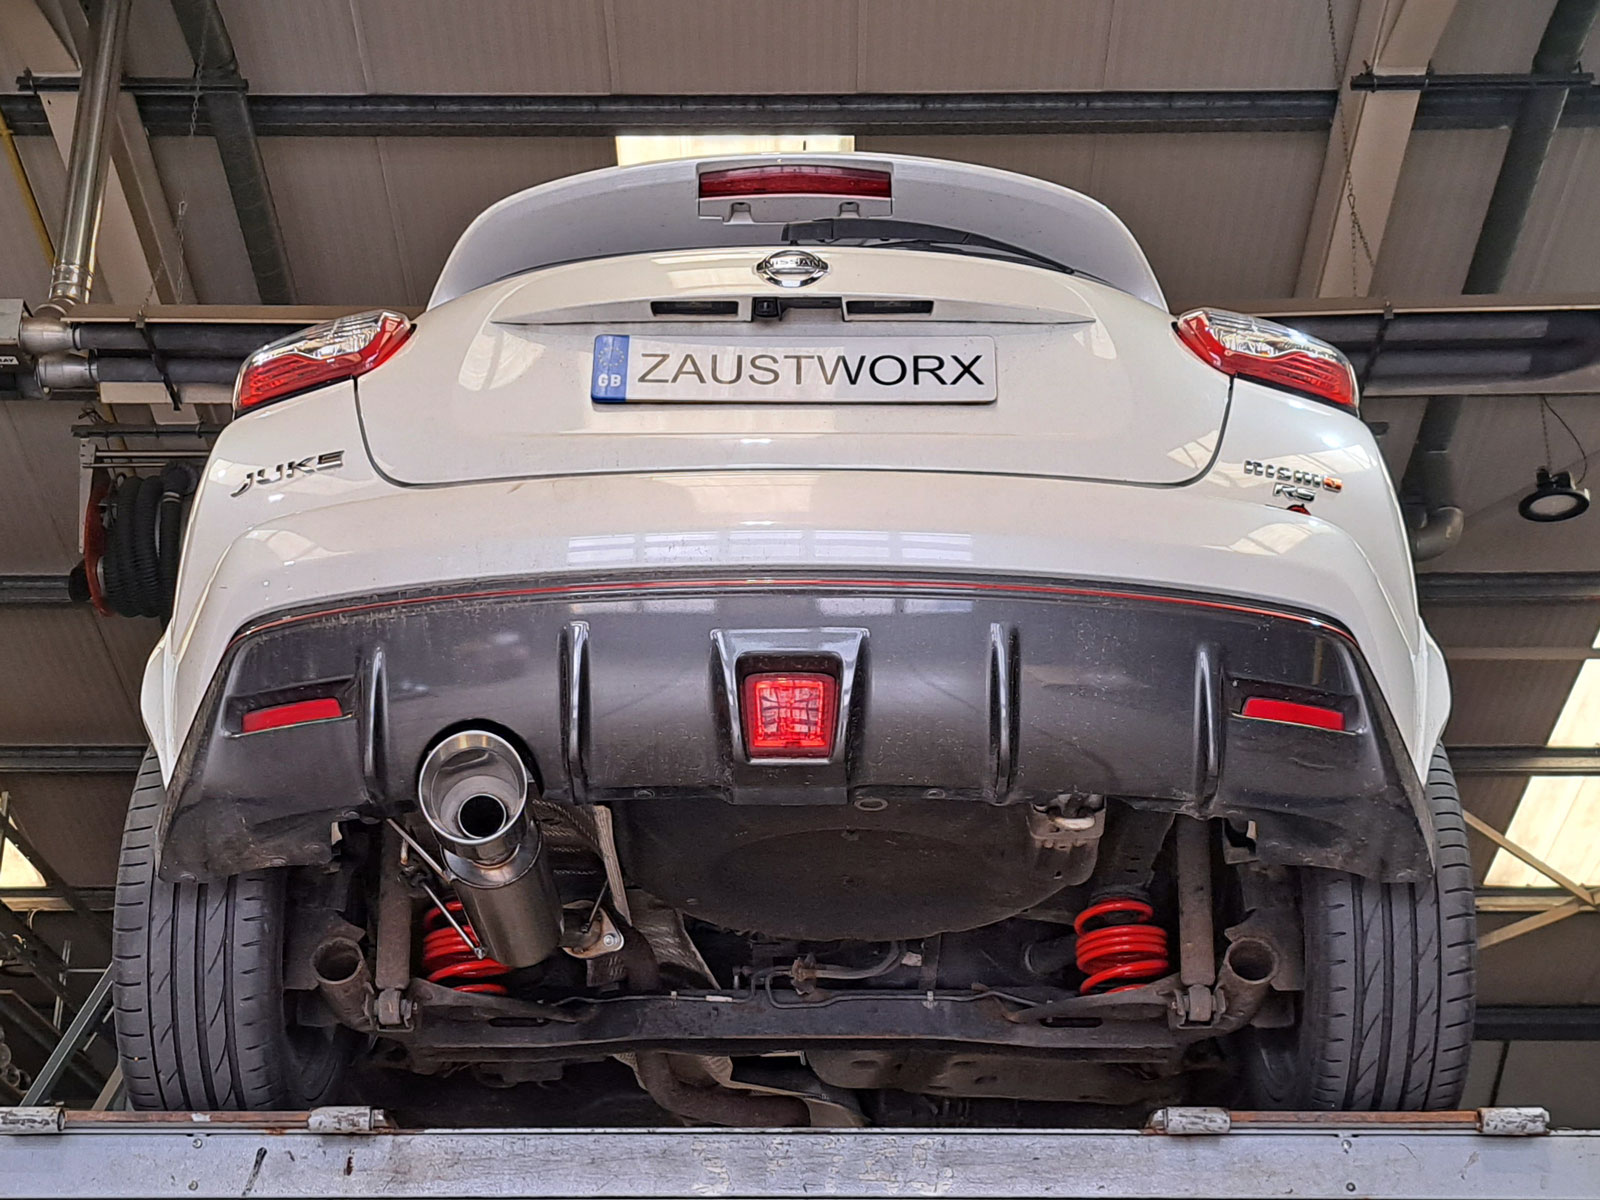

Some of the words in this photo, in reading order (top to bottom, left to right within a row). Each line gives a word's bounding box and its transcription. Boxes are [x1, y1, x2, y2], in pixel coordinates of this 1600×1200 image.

[598, 374, 621, 387] GB
[638, 353, 984, 385] ZAUSTWORX
[230, 450, 345, 497] JUKE
[1273, 483, 1316, 502] RS
